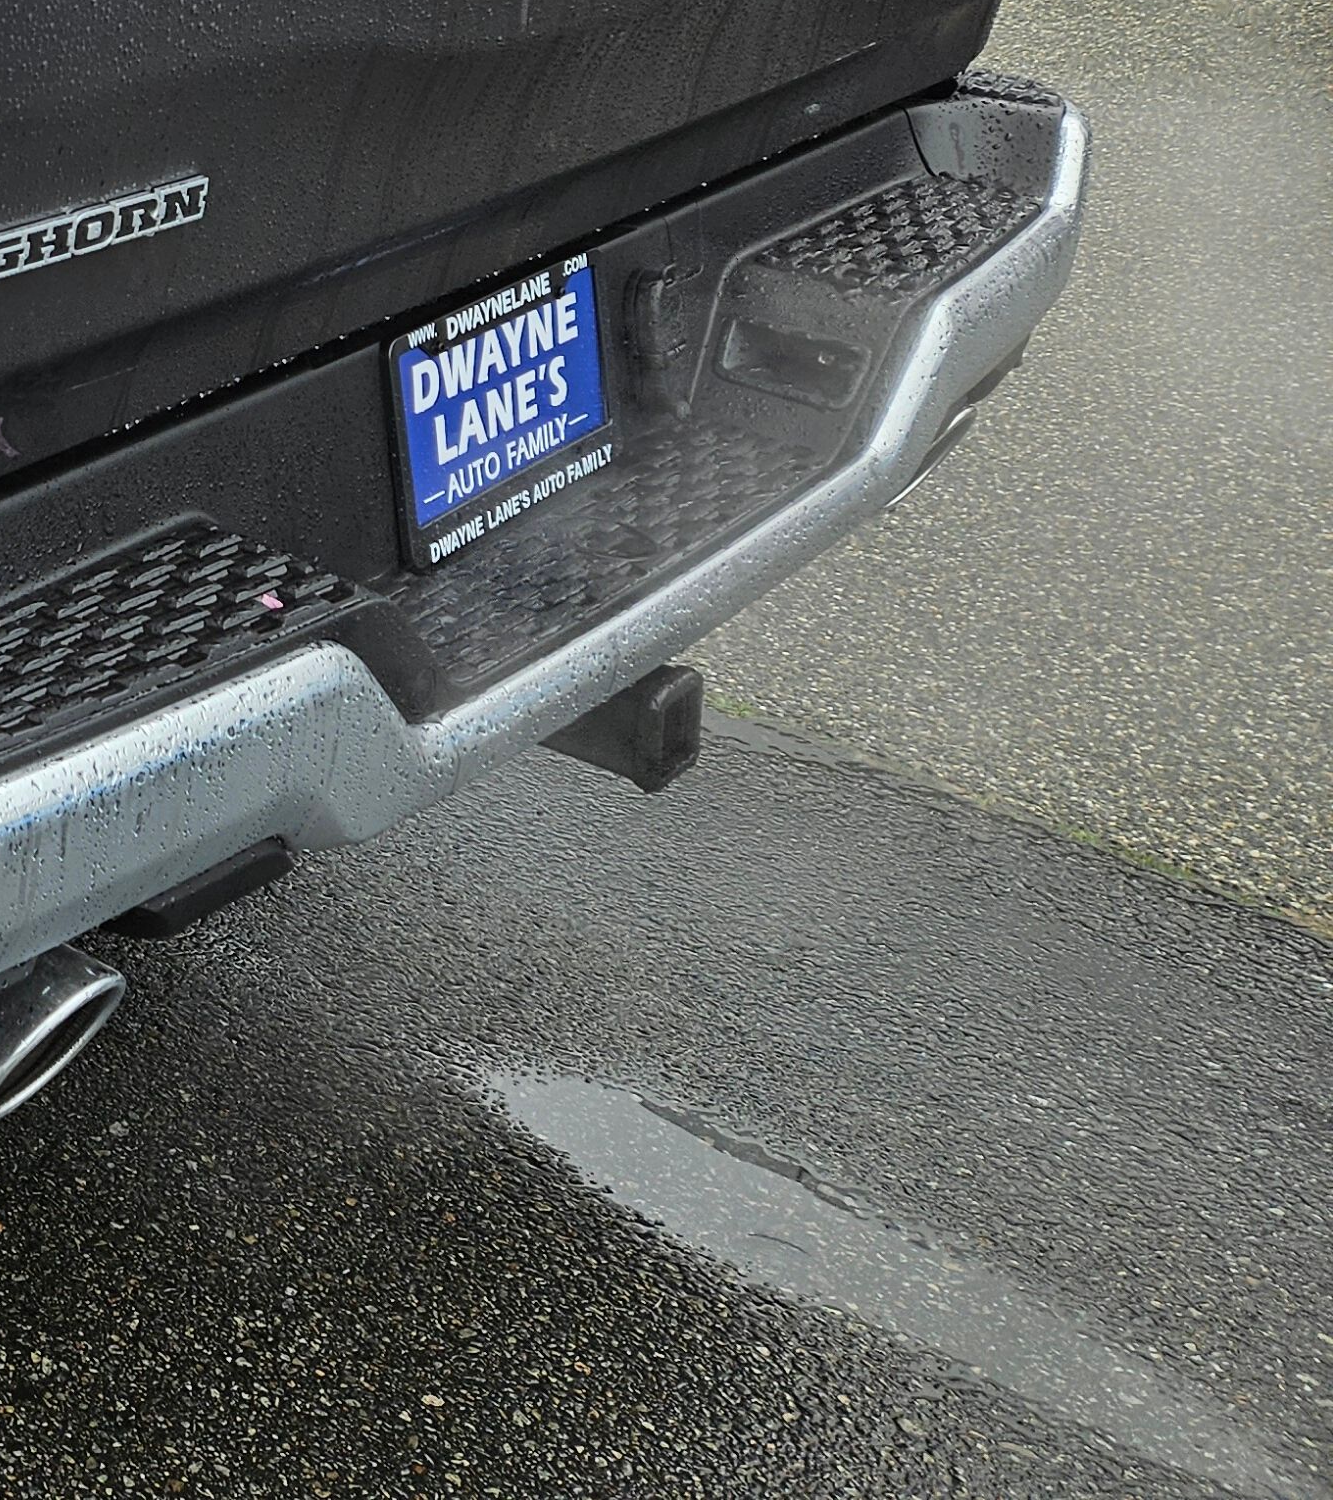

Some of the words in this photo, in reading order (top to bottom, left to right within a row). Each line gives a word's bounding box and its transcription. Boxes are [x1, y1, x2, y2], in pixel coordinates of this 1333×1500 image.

[446, 271, 552, 341] DWAYNELANE
[561, 252, 588, 277] .COM
[411, 291, 579, 415] DWAYNE
[434, 355, 569, 466] LANE'S
[447, 451, 501, 504] AUTO
[506, 413, 568, 470] FAMILY
[429, 515, 485, 564] DWAYNE
[486, 488, 531, 530] LANE'S
[533, 470, 565, 504] AUTO
[566, 443, 612, 484] FAMILY
